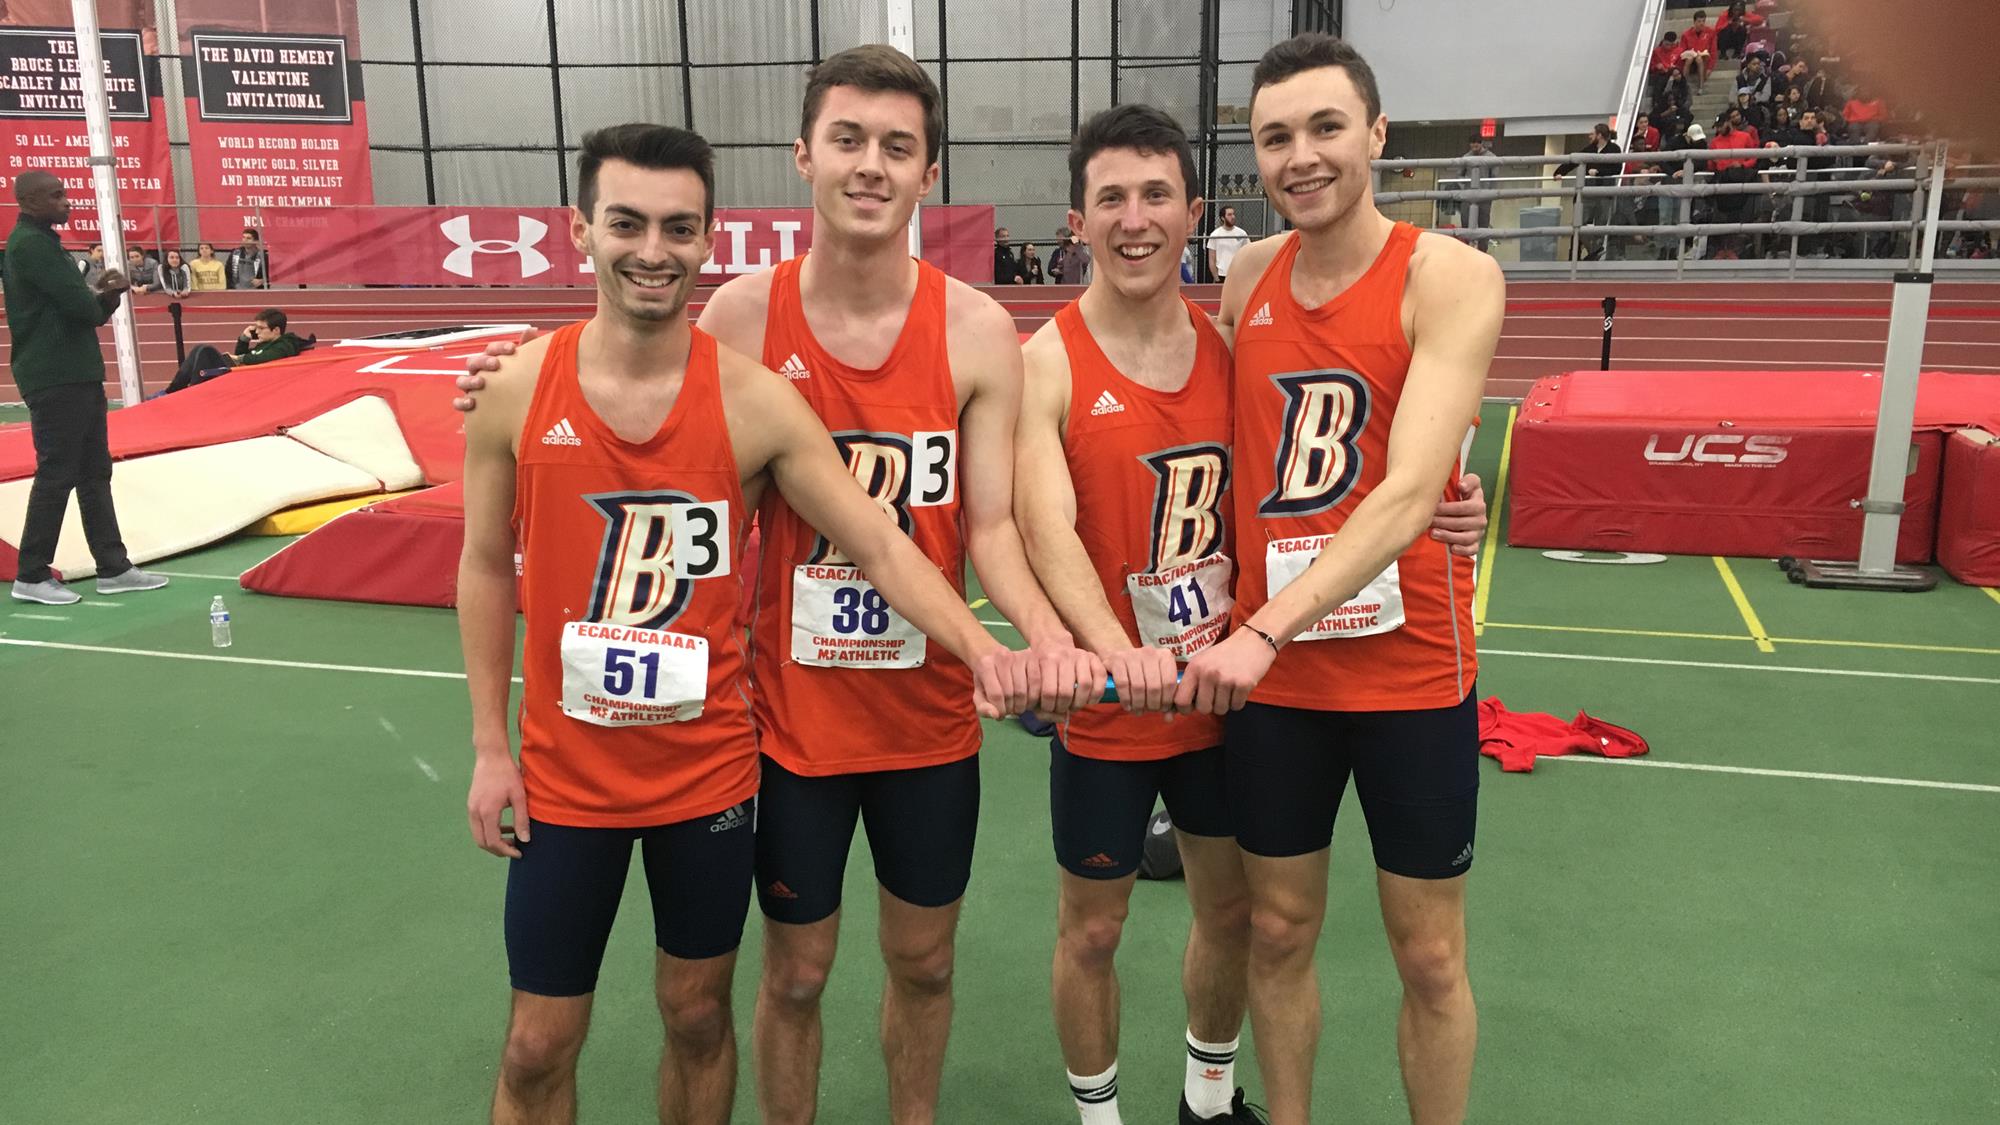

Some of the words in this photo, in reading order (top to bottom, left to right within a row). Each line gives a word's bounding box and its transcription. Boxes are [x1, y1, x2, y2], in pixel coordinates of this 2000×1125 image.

[48, 40, 75, 54] THE
[201, 47, 229, 62] THE
[233, 48, 275, 63] DAVID
[280, 50, 335, 65] HEMERY
[11, 57, 53, 72] BRUCE
[104, 78, 136, 92] HITE
[232, 70, 310, 86] VALENTINE
[19, 94, 117, 110] INVITATIL
[226, 92, 324, 109] INVITATIONAL
[15, 135, 28, 146] 50
[218, 136, 254, 149] WORLD
[258, 137, 297, 150] RECORD
[301, 138, 340, 151] HOLDER
[26, 156, 90, 168] CONFERENC
[221, 157, 268, 169] OLYMPIC
[302, 159, 339, 171] SILVER
[131, 178, 161, 190] YEAR
[221, 174, 243, 186] AND
[247, 175, 288, 187] BRONZE
[291, 176, 343, 188] MEDALIST
[236, 195, 242, 207] 2
[246, 195, 274, 207] TIME
[278, 196, 332, 207] OLYMPIAN
[1248, 317, 1274, 327] adidas
[783, 370, 810, 380] didas
[1091, 402, 1125, 416] adidas
[542, 434, 582, 446] adidas
[1258, 373, 1369, 514] B
[1643, 434, 1793, 463] UCS
[922, 435, 951, 503] 3
[1147, 446, 1230, 574] B
[686, 507, 720, 576] 3
[593, 495, 690, 628] B
[1168, 576, 1210, 627] 41
[832, 587, 890, 635] 38
[1158, 611, 1228, 645] CHAMPIONSHIP
[1316, 616, 1379, 632] ATHLETIC
[577, 624, 697, 650] ECAC/ICAAAA
[812, 636, 906, 649] CHAMPIONSHIP
[838, 650, 900, 661] ATHLETIC
[603, 647, 660, 699] 51
[583, 693, 682, 713] CHAMPIONSHIP
[610, 710, 676, 721] ATHLETIC
